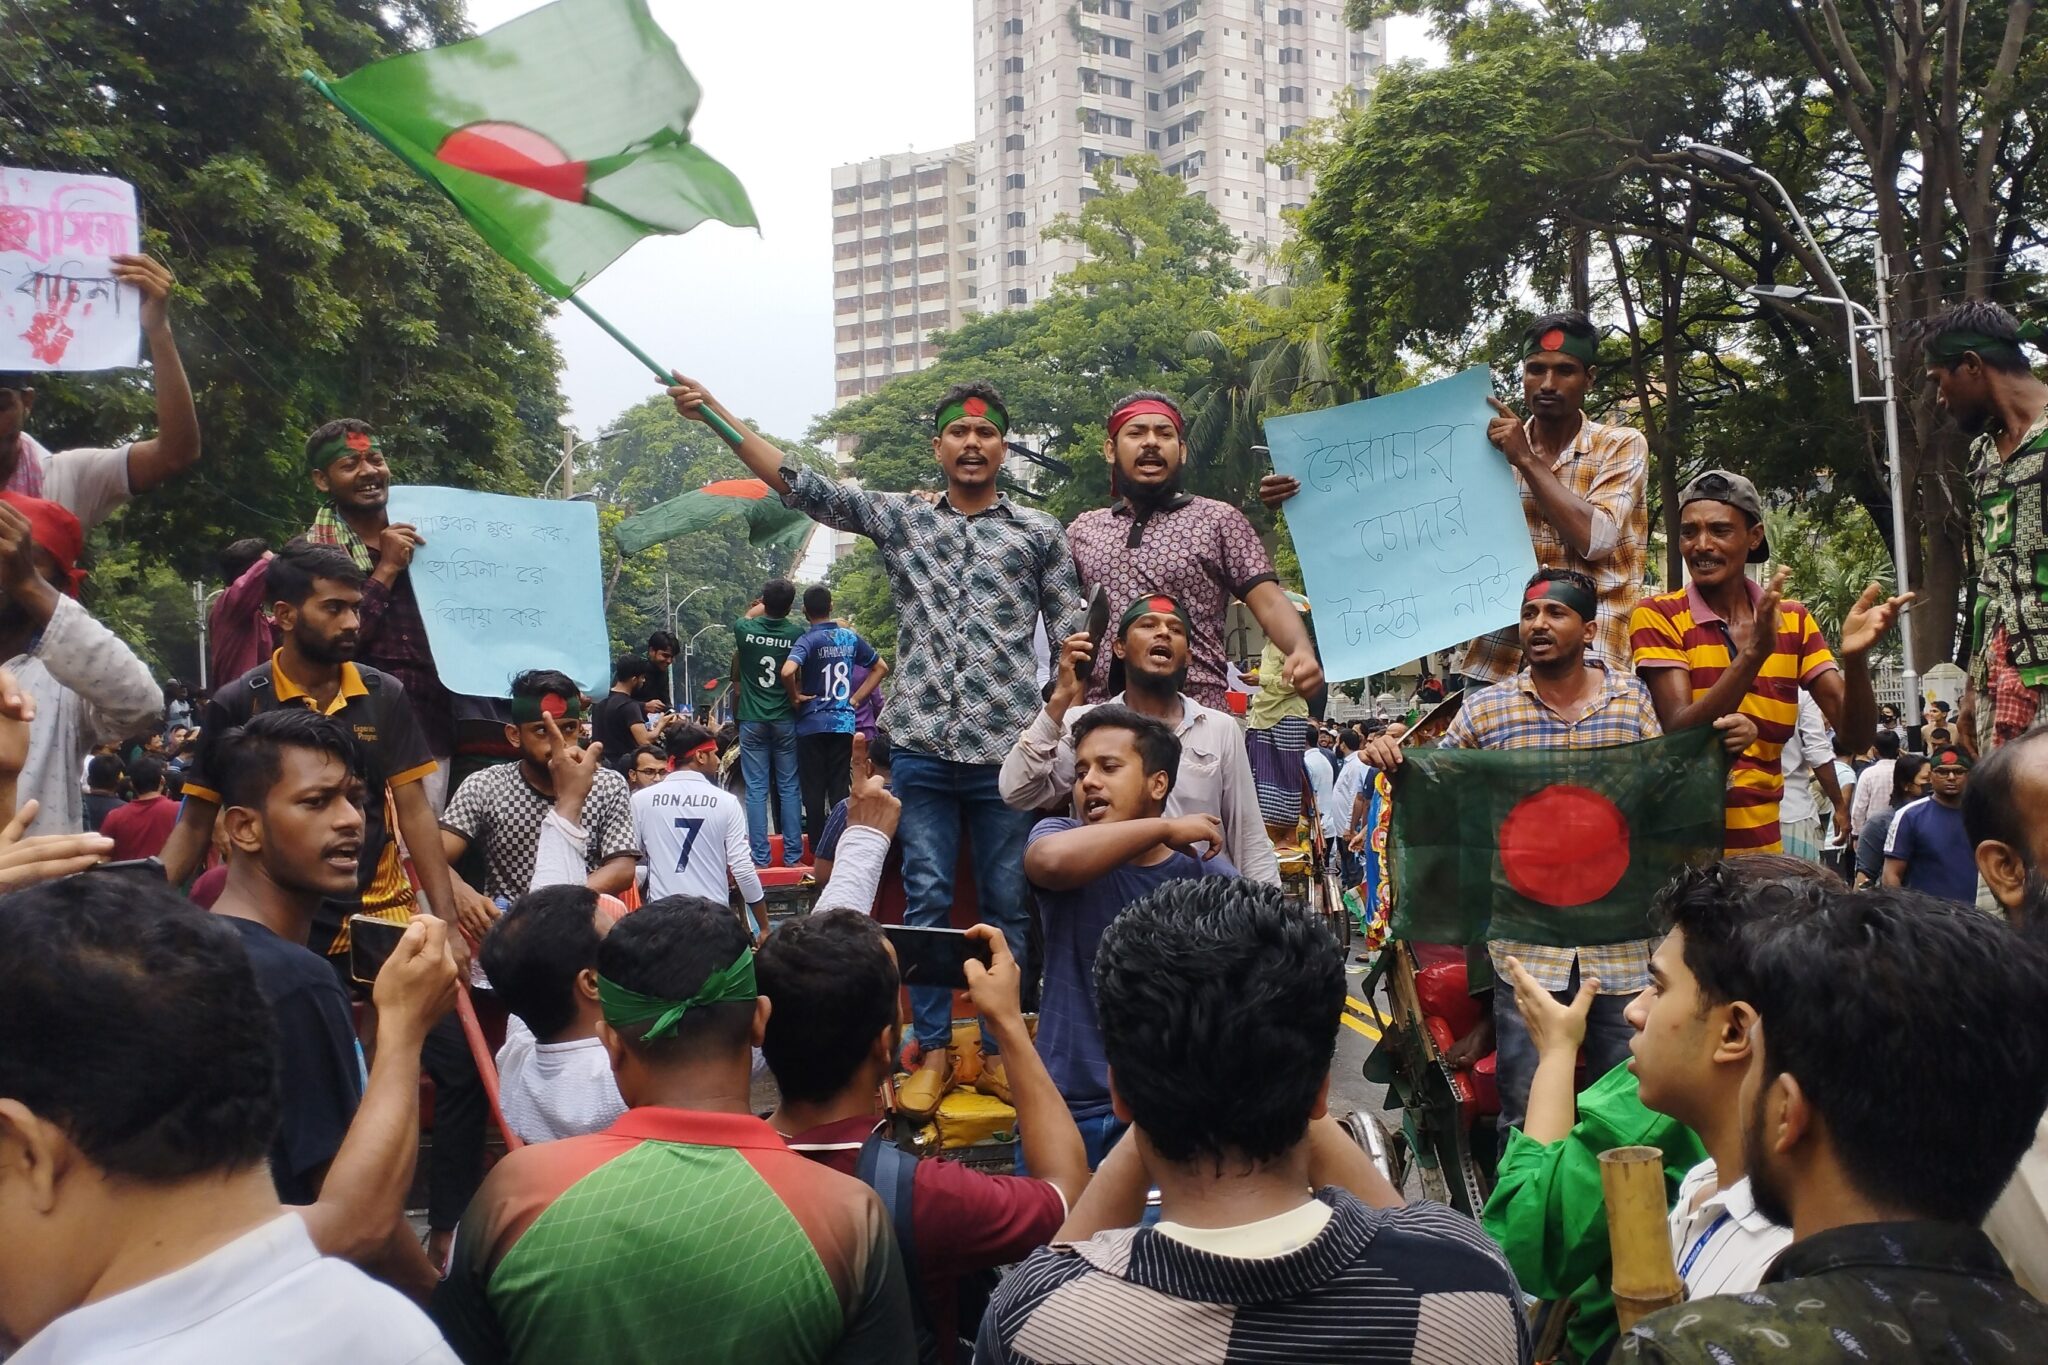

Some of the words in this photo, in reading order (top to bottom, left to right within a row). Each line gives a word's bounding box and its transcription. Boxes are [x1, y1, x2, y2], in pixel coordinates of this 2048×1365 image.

[745, 633, 793, 649] ROBIUL
[758, 656, 776, 688] 3
[821, 662, 850, 702] 18
[652, 793, 718, 809] RONALDO
[674, 817, 704, 873] 7
